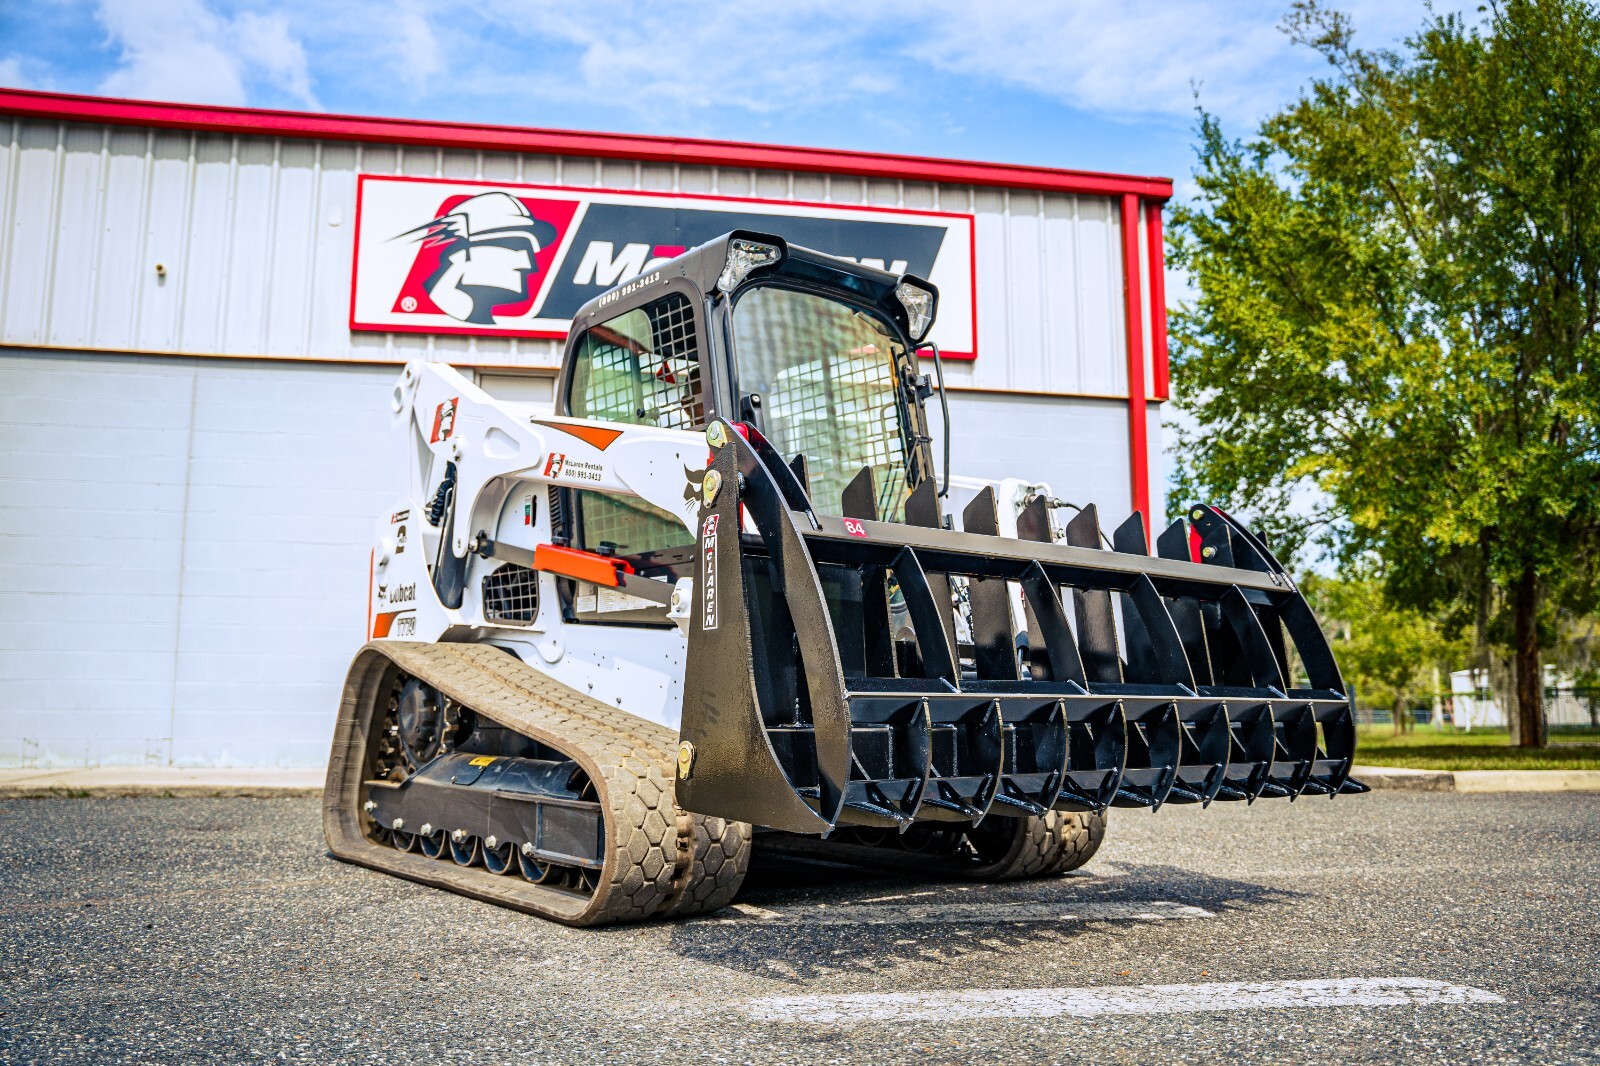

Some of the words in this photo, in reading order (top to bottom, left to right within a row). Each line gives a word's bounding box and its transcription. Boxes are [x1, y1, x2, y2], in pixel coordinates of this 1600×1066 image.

[598, 290, 620, 308] (800)
[621, 271, 660, 297] 991-3413
[564, 459, 584, 468] McLaren
[584, 462, 603, 471] Rentals
[845, 521, 865, 535] 84
